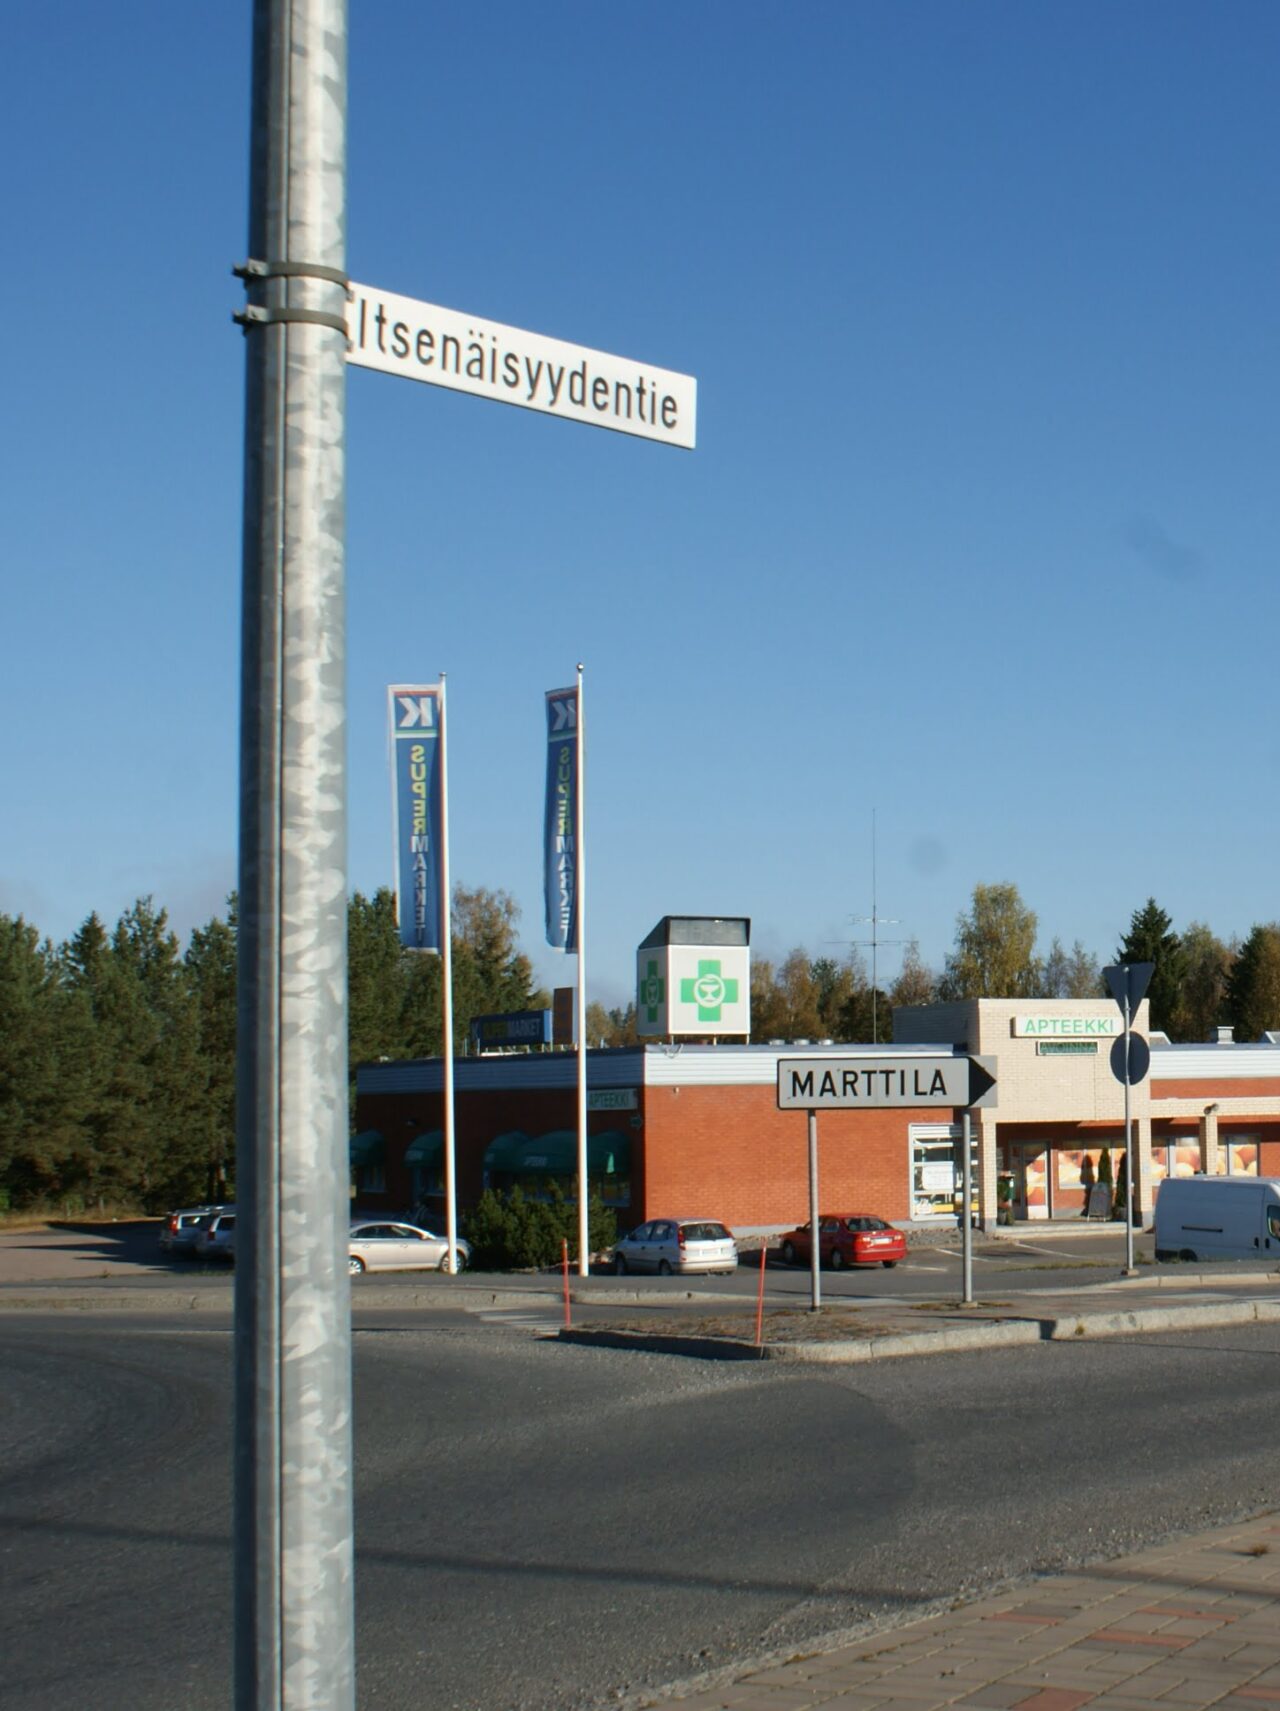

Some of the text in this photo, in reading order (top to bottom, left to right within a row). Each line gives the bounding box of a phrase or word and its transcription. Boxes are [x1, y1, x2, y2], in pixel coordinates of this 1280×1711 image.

[359, 298, 679, 430] Itsenäisyydentie
[1025, 1018, 1114, 1034] APTEEKKI
[792, 1069, 948, 1098] MARTTILA
